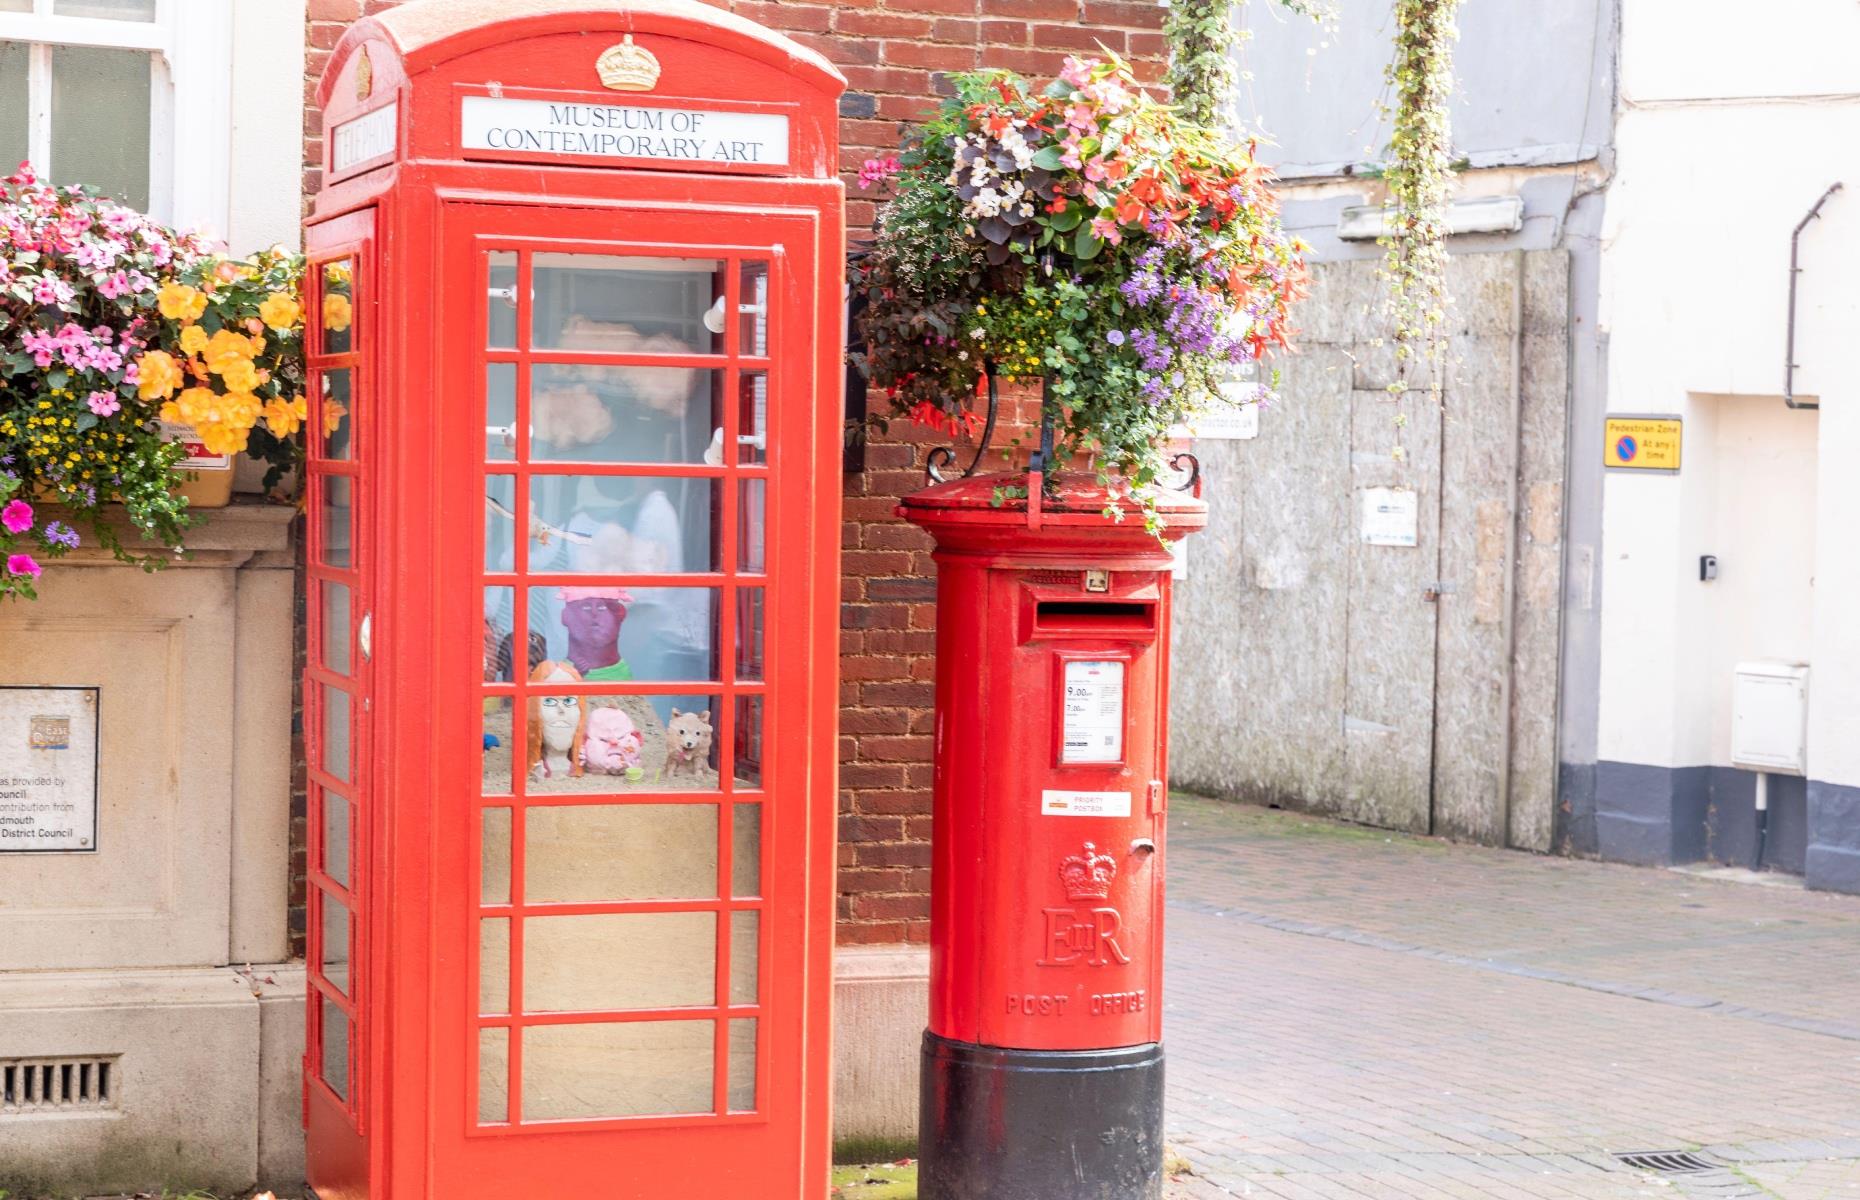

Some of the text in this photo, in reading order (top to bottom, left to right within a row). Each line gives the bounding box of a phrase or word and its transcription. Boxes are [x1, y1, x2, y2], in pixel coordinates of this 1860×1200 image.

[549, 105, 705, 133] MUSEUM OF
[487, 127, 764, 162] CONTEMPORARY ART
[1609, 423, 1678, 434] Pedestrian Zone
[1642, 440, 1671, 451] At any
[1646, 451, 1665, 460] time
[0, 777, 66, 788] as provided by
[0, 790, 26, 799] ouncil
[0, 802, 75, 812] ontribution from
[0, 815, 35, 825] dmouth
[1, 828, 73, 838] District Council
[1006, 989, 1146, 1016] POST OFFICE
